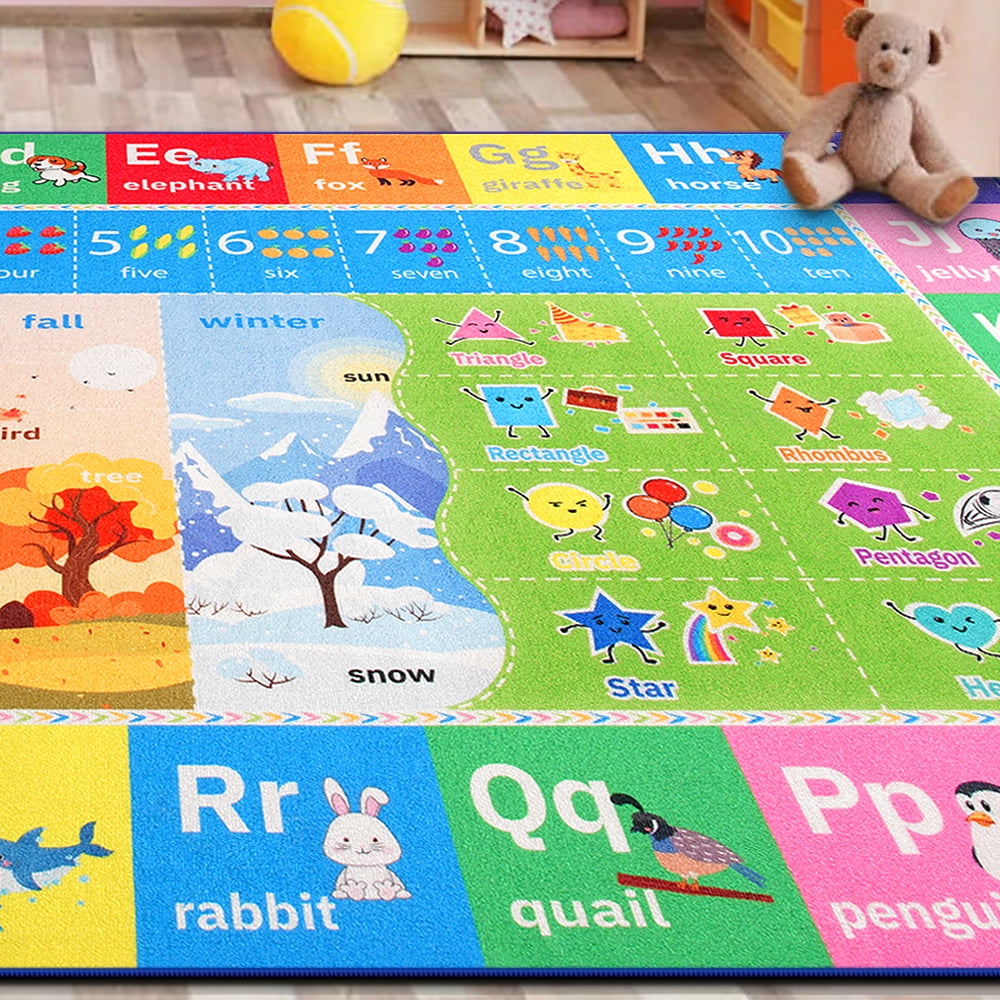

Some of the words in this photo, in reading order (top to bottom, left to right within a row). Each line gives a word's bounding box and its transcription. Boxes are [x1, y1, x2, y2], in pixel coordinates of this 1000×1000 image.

[126, 143, 197, 165] Ee
[303, 142, 362, 165] Ff
[469, 144, 560, 170] Gg
[642, 142, 735, 165] Hh
[124, 179, 255, 192] elephant
[314, 179, 367, 191] fox
[481, 178, 583, 193] giraffe
[666, 178, 762, 191] horse
[89, 231, 121, 256] 5
[218, 230, 254, 255] 6
[355, 230, 387, 254] 7
[489, 230, 528, 255] 8
[616, 229, 655, 254] 9
[733, 229, 793, 255] 10
[888, 219, 963, 254] Jj
[121, 266, 168, 279] five
[265, 266, 299, 279] six
[392, 267, 459, 279] seven
[522, 266, 593, 282] eight
[667, 266, 727, 279] nine
[803, 266, 851, 279] ten
[22, 314, 85, 330] fall
[199, 314, 325, 330] winter
[450, 352, 545, 367] Triangle
[719, 352, 808, 367] Square
[343, 370, 391, 383] sun
[487, 446, 607, 464] Rectangle
[777, 447, 889, 463] Rhombus
[80, 468, 143, 484] tree
[550, 551, 638, 569] Circle
[853, 548, 977, 570] Pentagon
[348, 668, 436, 684] snow
[607, 678, 676, 699] Star
[177, 764, 299, 834] Rr
[470, 763, 630, 853] Qq
[781, 766, 943, 855] Pp
[175, 892, 340, 931] rabbit
[511, 890, 671, 937] quail
